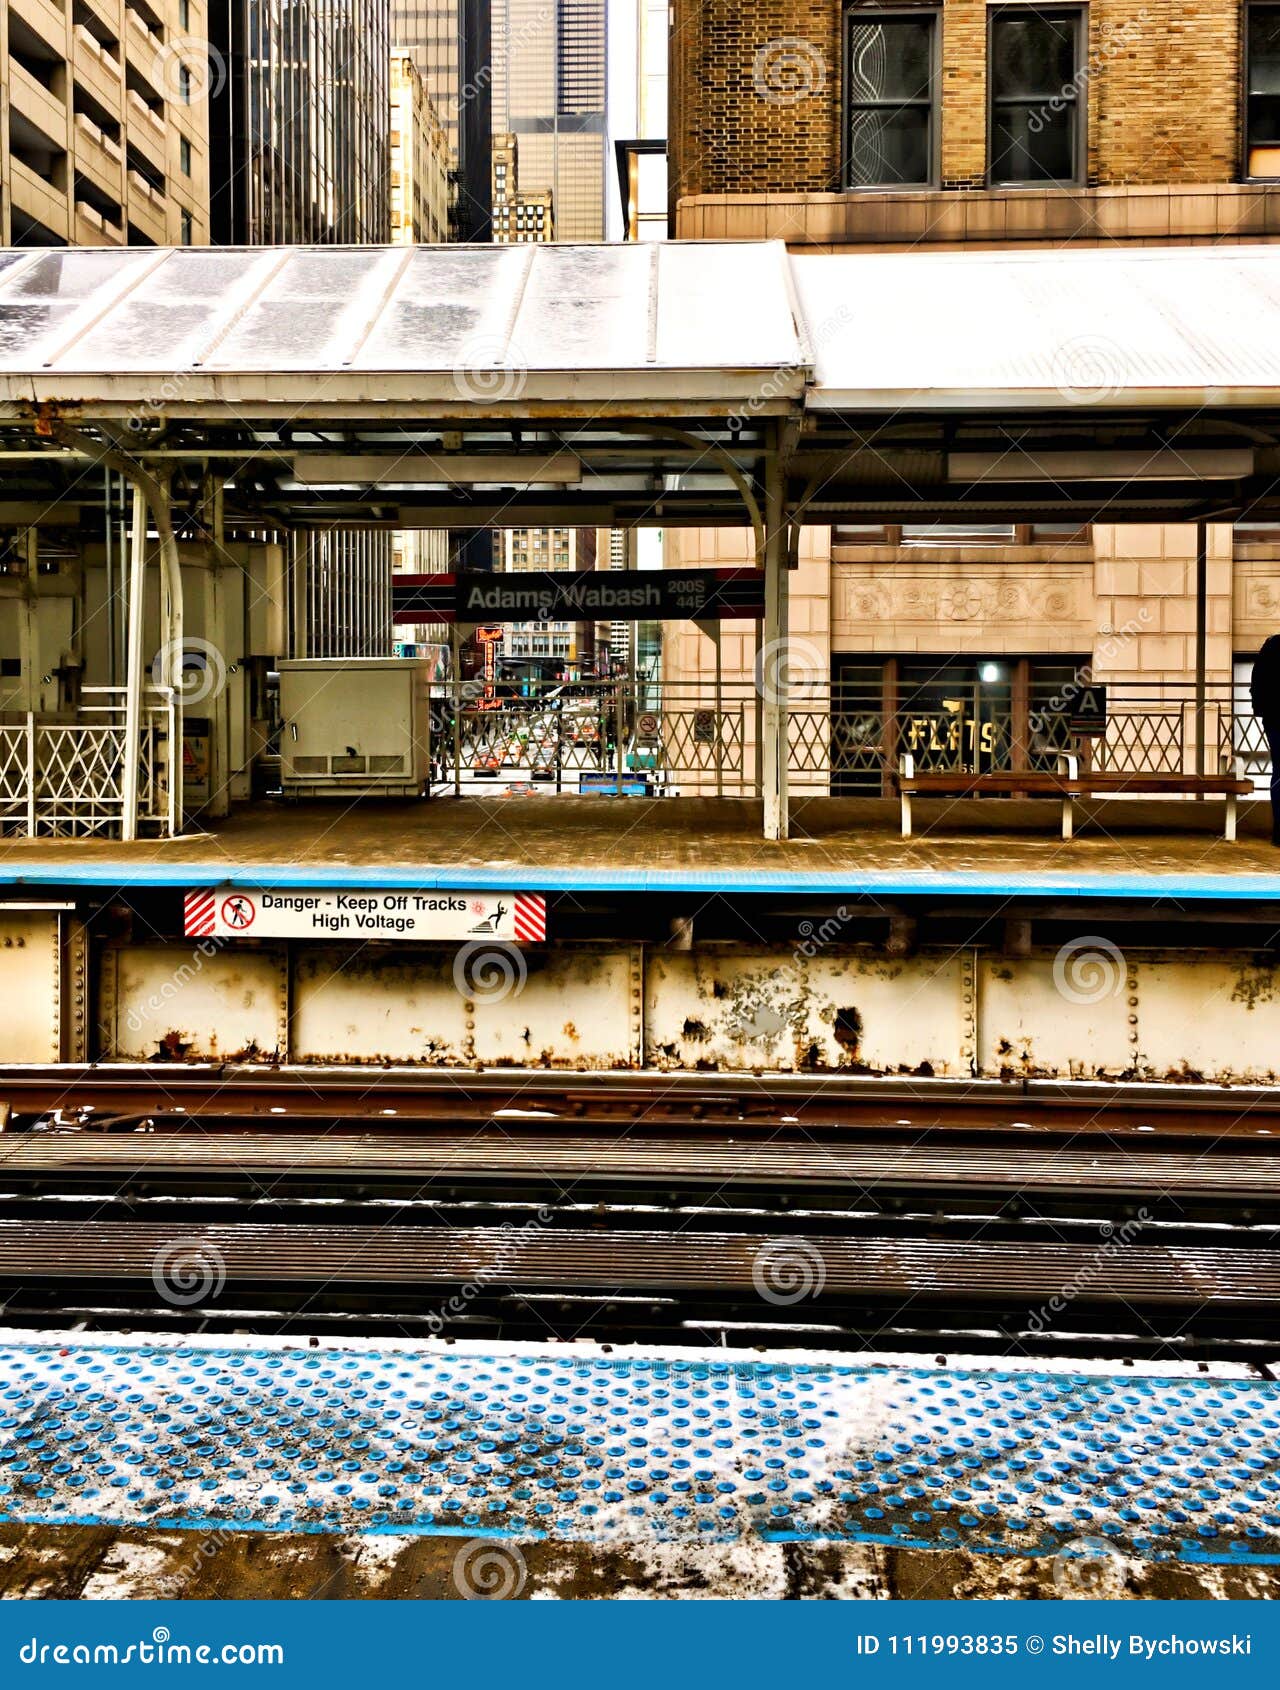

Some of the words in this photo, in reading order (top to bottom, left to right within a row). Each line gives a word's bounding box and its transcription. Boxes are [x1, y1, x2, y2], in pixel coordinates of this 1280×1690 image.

[667, 580, 705, 593] 200S
[467, 583, 661, 609] Adams/Wabash
[676, 595, 705, 608] 44E
[1078, 690, 1099, 713] A
[908, 719, 996, 753] FLATS
[261, 894, 319, 910] Danger
[336, 895, 378, 912] Keep
[383, 895, 409, 910] Off
[412, 896, 467, 911] Tracks
[312, 913, 350, 931] High
[354, 914, 416, 930] Voltage
